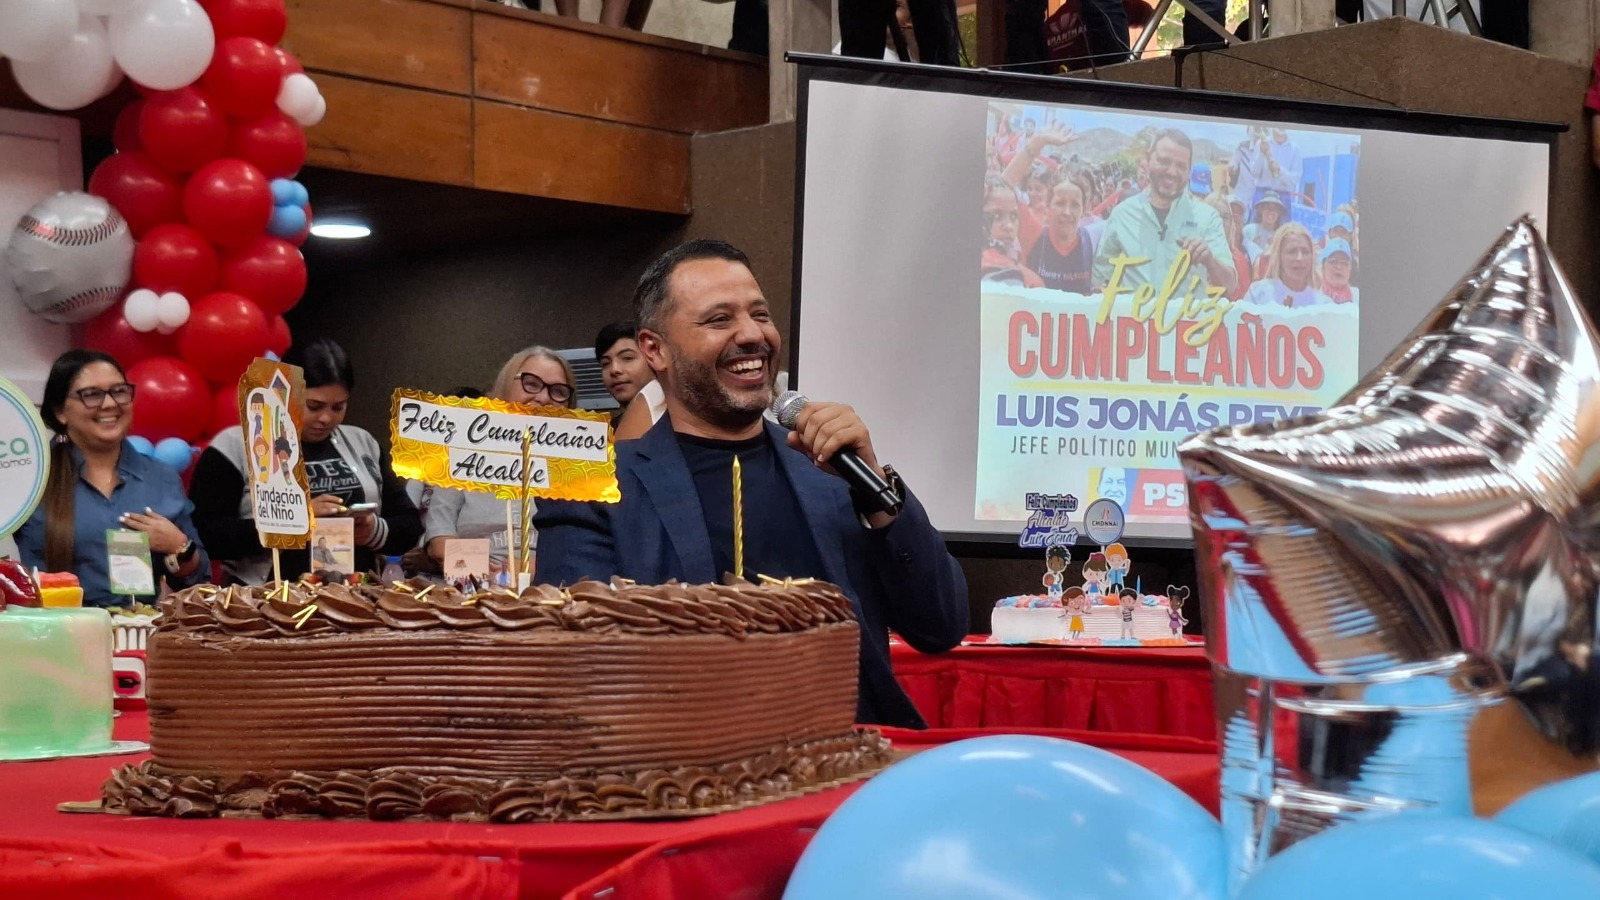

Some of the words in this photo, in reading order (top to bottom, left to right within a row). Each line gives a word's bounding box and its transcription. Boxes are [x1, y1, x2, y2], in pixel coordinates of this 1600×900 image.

[1096, 250, 1233, 346] Feliz
[1007, 310, 1325, 388] CUMPLEAÑOS
[401, 403, 457, 444] Feliz
[996, 394, 1079, 429] LUIS
[1087, 393, 1219, 432] JONÁS
[1011, 436, 1049, 455] JEFE
[1058, 435, 1137, 458] POLÍTICO
[256, 484, 302, 505] Fundación
[1026, 493, 1041, 509] Feliz
[1142, 483, 1189, 507] PS
[258, 503, 269, 518] del
[271, 504, 294, 520] Niño
